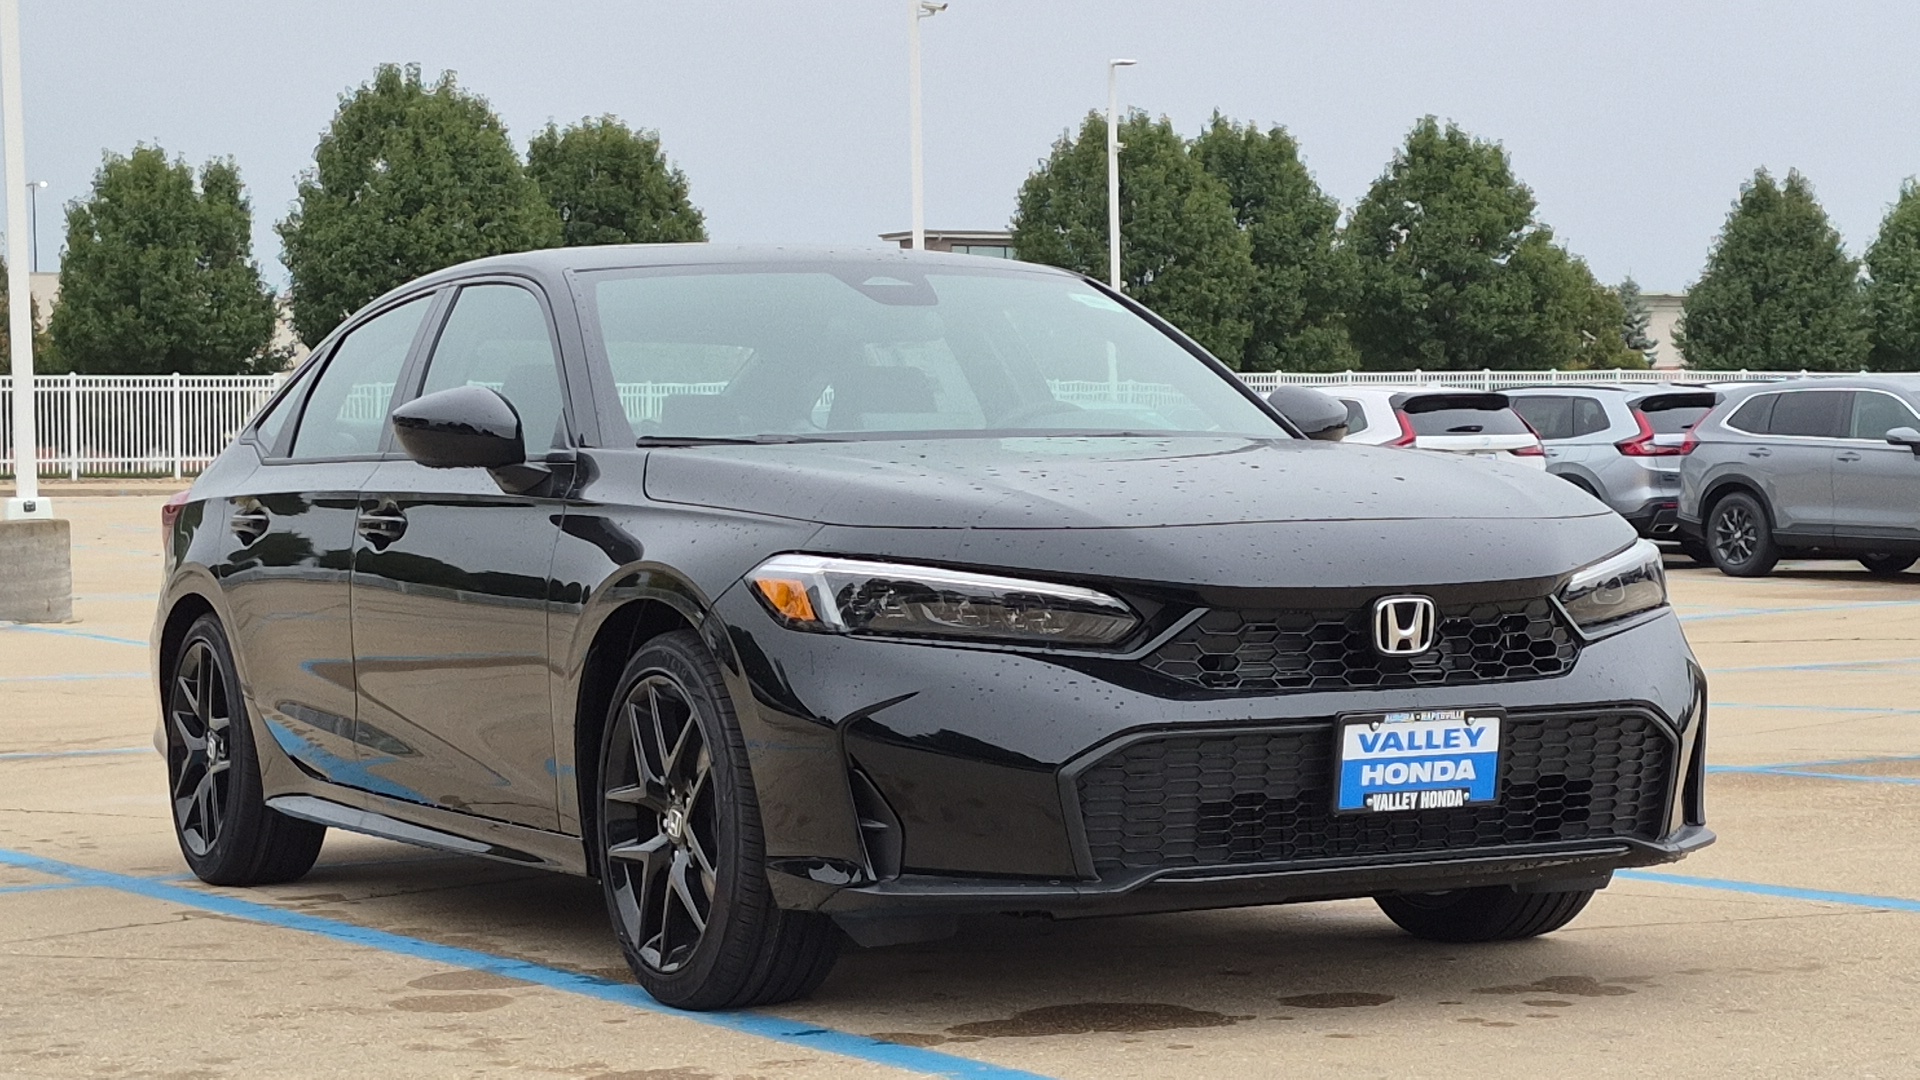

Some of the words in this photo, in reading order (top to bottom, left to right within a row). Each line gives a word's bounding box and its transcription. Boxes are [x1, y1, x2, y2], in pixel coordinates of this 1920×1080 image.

[1358, 727, 1486, 753] VALLEY
[1361, 759, 1476, 786] HONDA
[1372, 791, 1418, 812] VALLEY
[1420, 789, 1463, 809] HONDA
